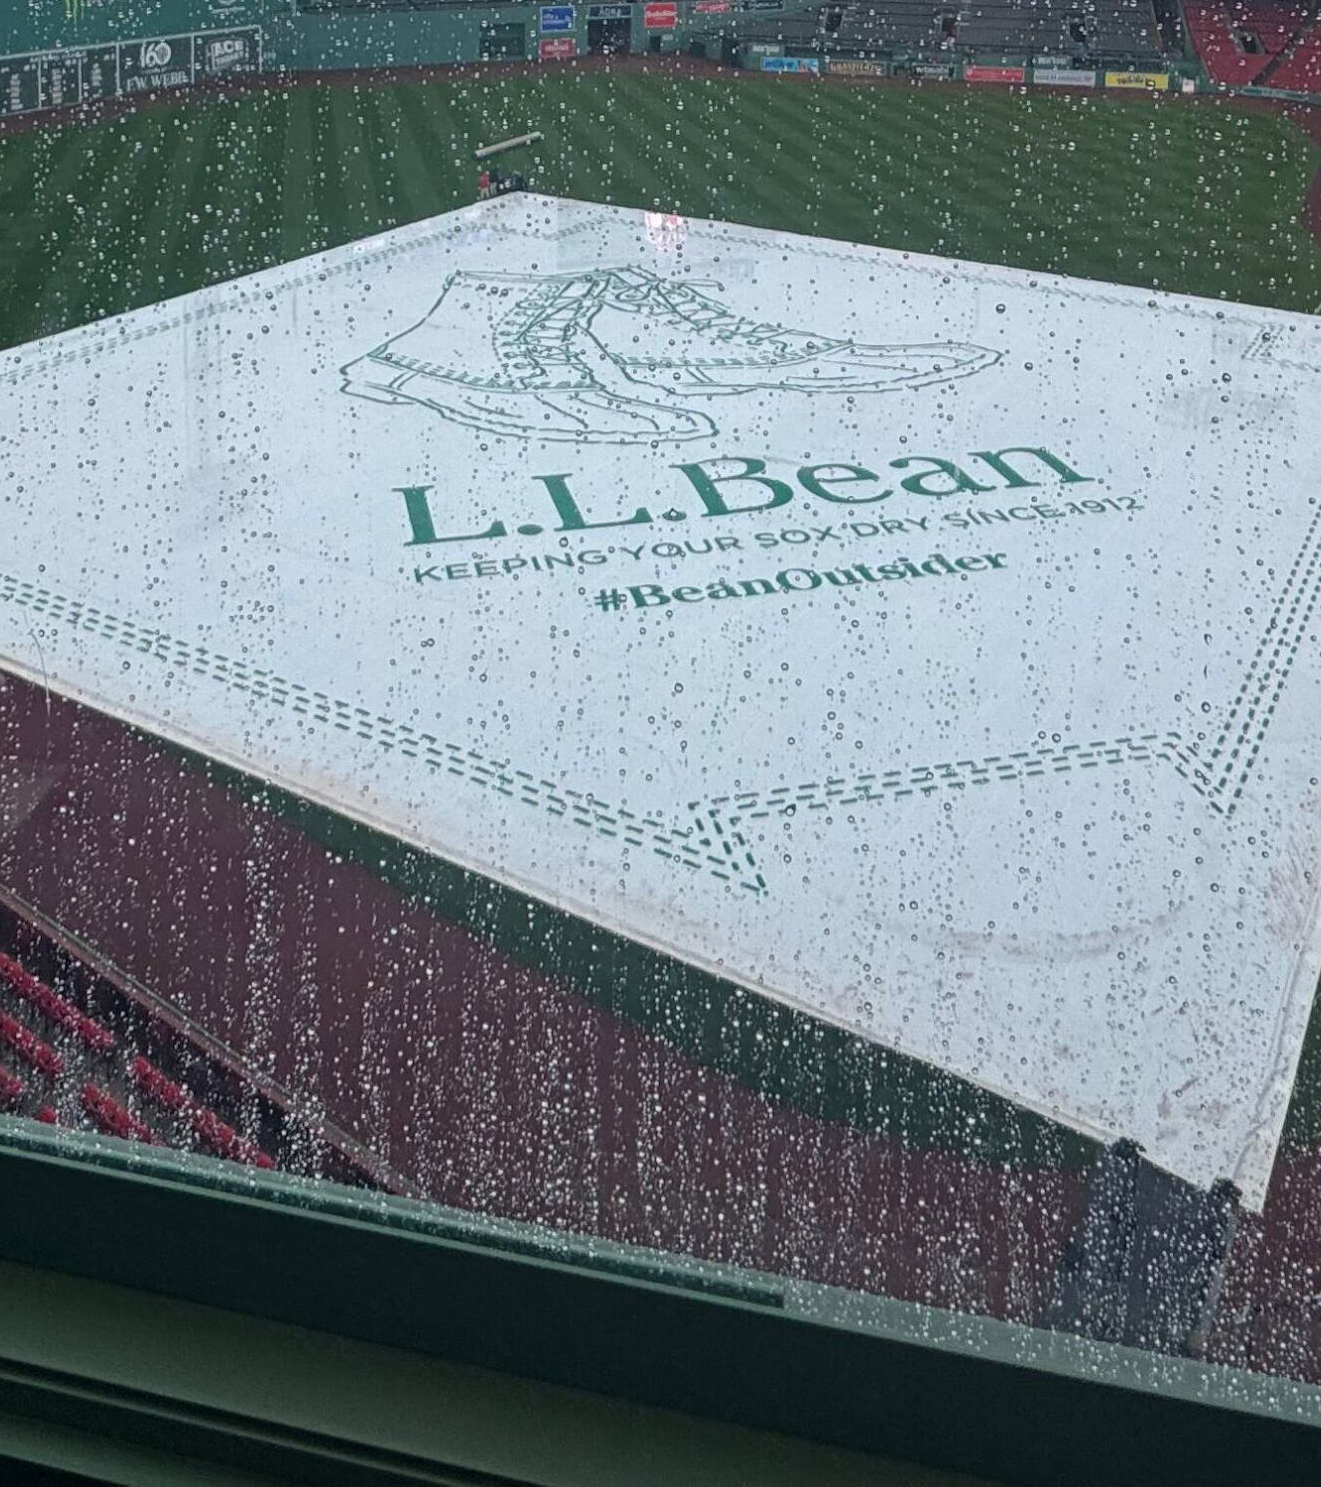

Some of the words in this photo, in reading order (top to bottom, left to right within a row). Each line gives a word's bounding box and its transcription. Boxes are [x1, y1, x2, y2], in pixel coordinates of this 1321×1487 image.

[214, 40, 244, 58] ACE
[392, 447, 1095, 546] L.L.Bean
[414, 547, 616, 583] KEEPING
[621, 535, 743, 563] YOUR
[755, 524, 839, 549] SOX
[849, 516, 932, 541] DRY
[942, 505, 1058, 530] SINCE
[1069, 495, 1146, 517] 1912
[593, 547, 1010, 613] #BeanOutsider
